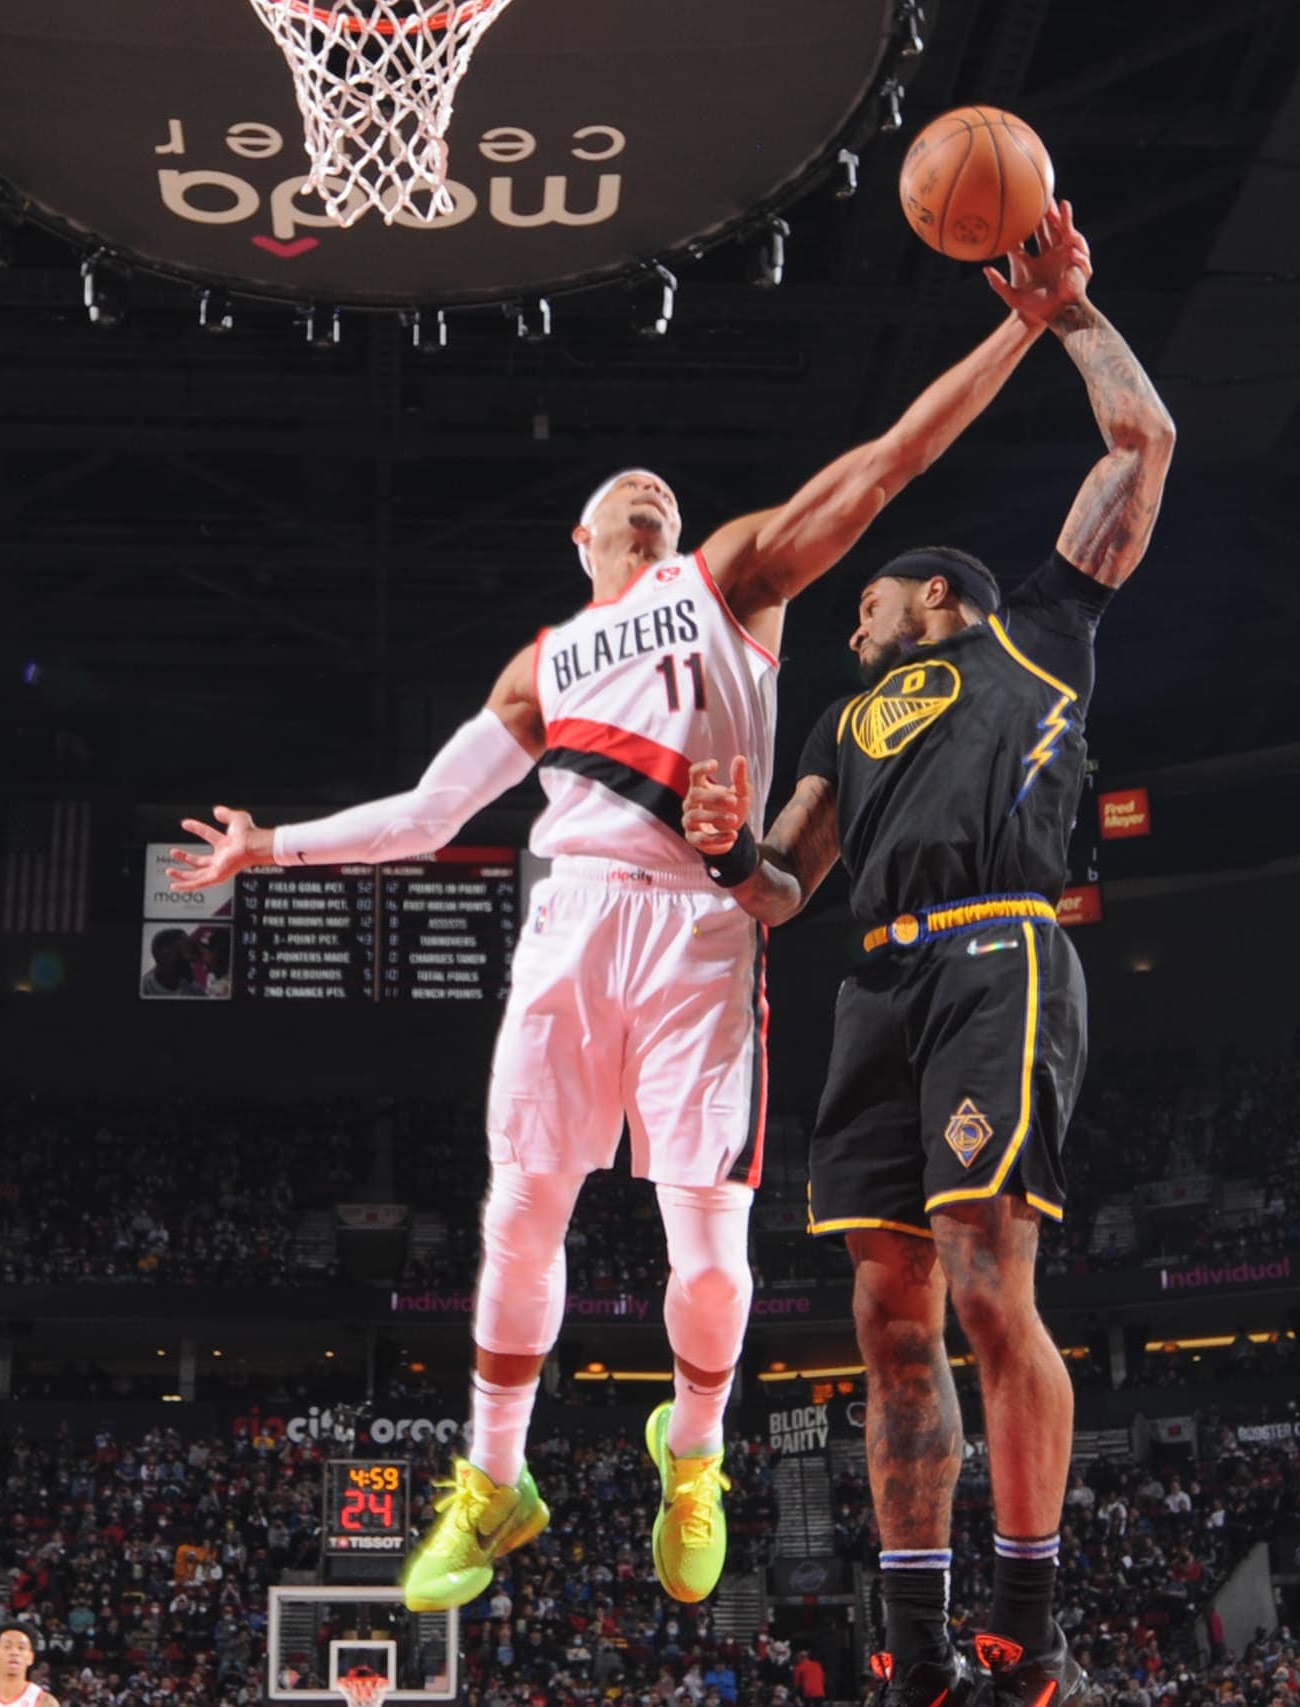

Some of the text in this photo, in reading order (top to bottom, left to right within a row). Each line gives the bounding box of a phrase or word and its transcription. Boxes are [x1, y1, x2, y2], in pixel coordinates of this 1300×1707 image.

[156, 120, 627, 163] ceer
[157, 169, 622, 240] moda
[552, 599, 700, 693] BLAZERS
[655, 652, 708, 713] 11
[902, 669, 926, 695] 0
[1104, 800, 1136, 816] Fred
[1160, 1256, 1291, 1292] Individual
[752, 1294, 811, 1314] care
[769, 1404, 829, 1434] BLOCK
[769, 1427, 830, 1455] PARTY
[349, 1466, 399, 1491] 4:59
[340, 1488, 393, 1530] 24
